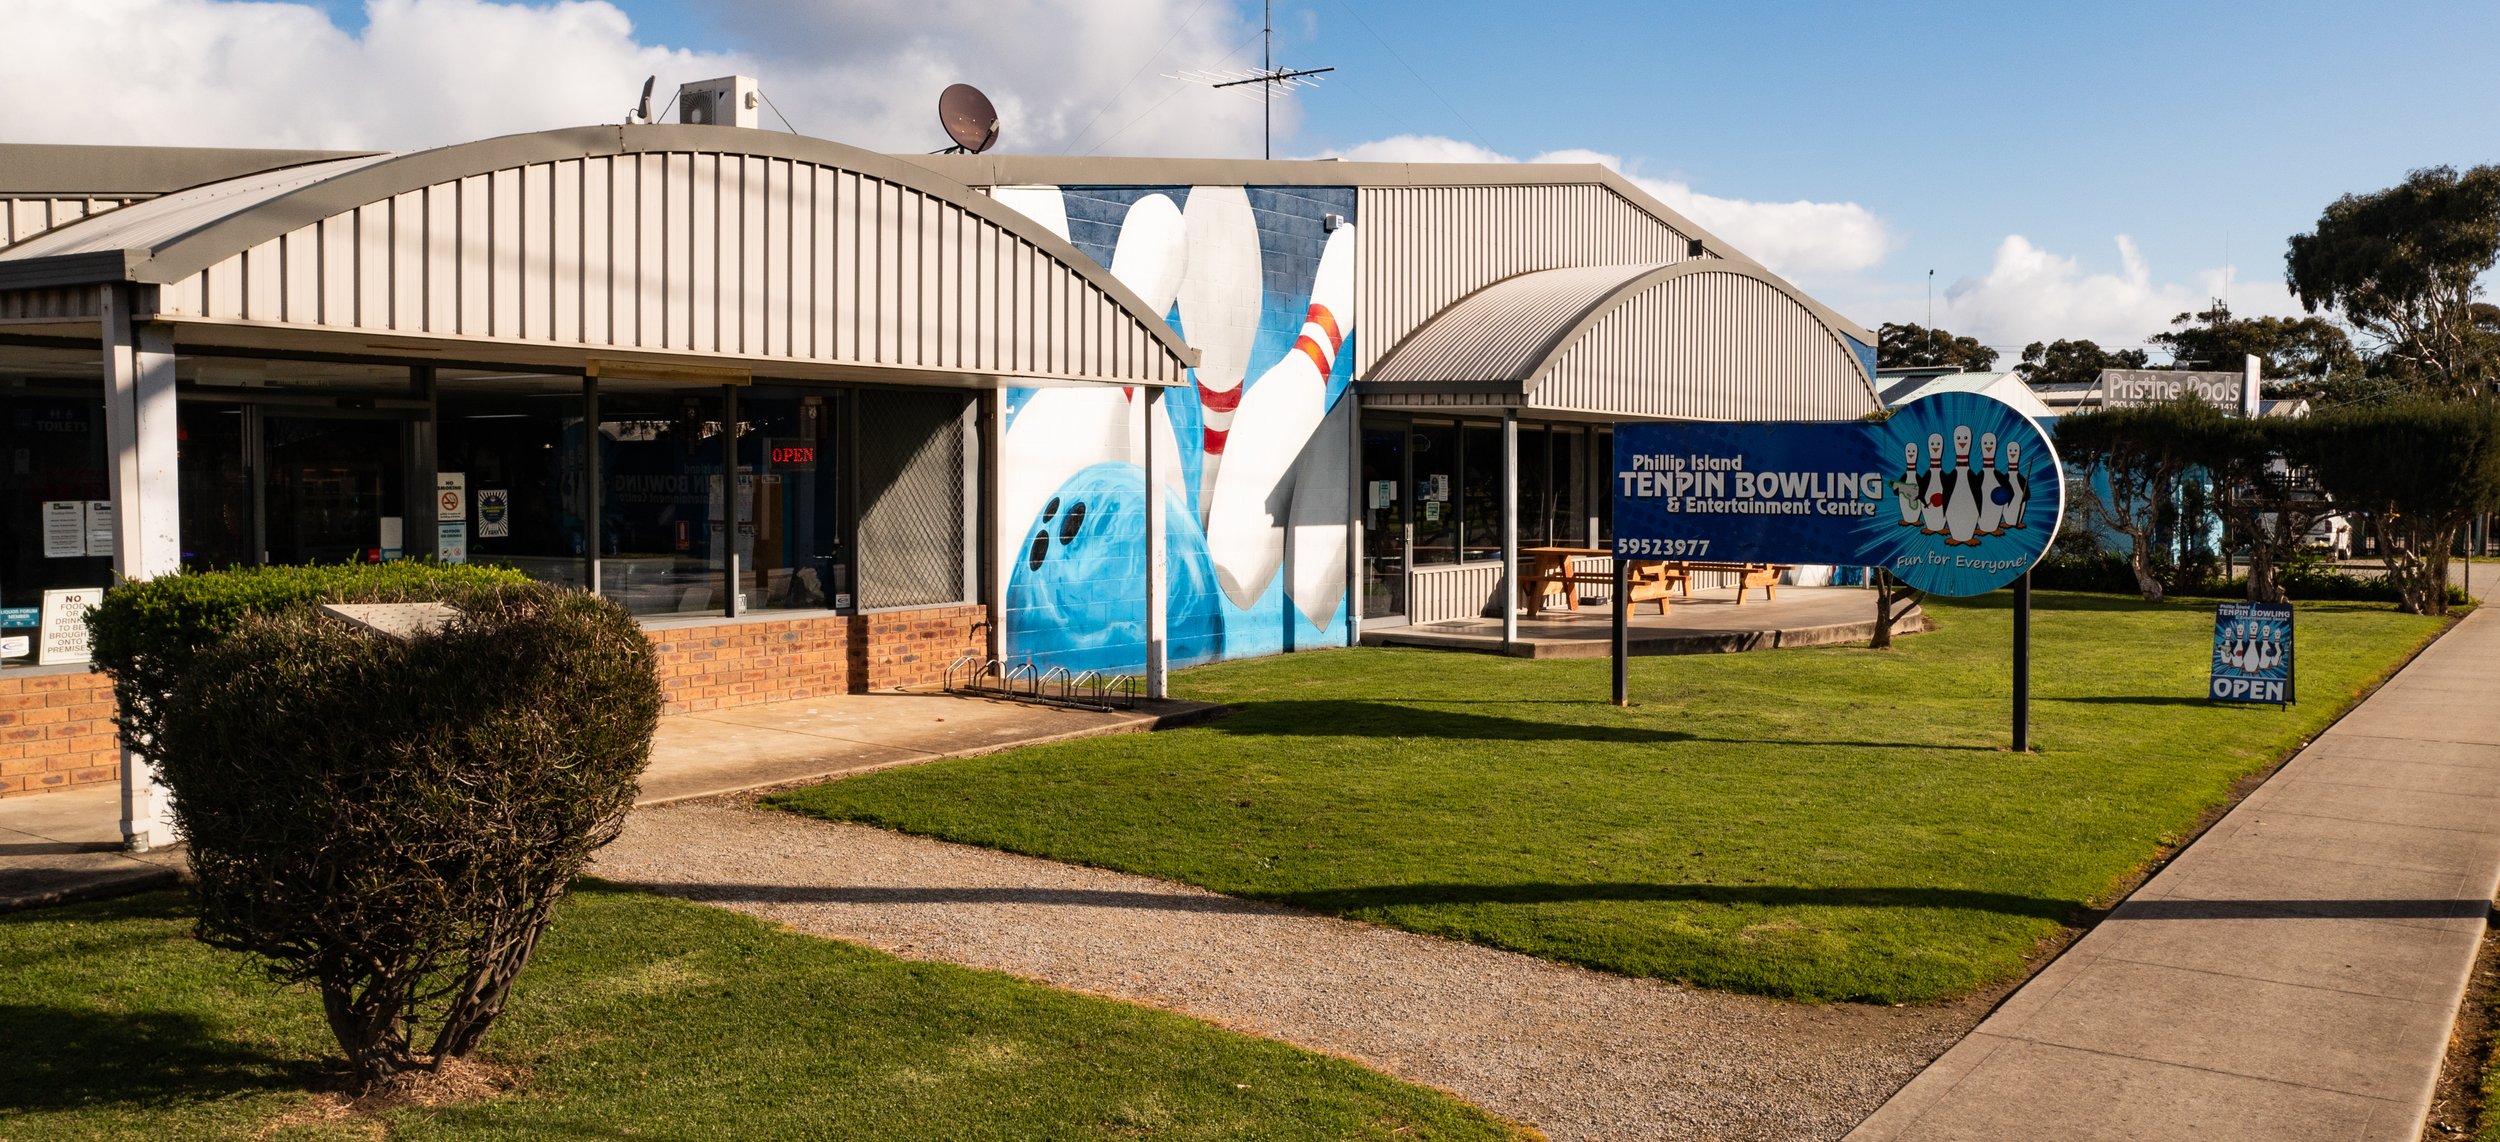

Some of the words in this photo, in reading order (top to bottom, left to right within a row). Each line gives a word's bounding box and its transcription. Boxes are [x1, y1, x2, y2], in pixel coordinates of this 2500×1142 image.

[2109, 373, 2181, 400] Pristine
[2187, 375, 2240, 402] Pools
[2109, 400, 2128, 408] POOL
[37, 420, 88, 432] TOILETS
[771, 447, 815, 463] OPEN
[1632, 454, 1686, 475] Phillip
[1691, 454, 1742, 471] Island
[1619, 471, 1725, 497] TENPIN
[1735, 471, 1882, 499] BOWLING
[1667, 497, 1680, 513] &
[1686, 496, 1811, 515] Entertainment
[1816, 498, 1876, 515] Centre
[1618, 538, 1710, 556] 59523977
[1897, 555, 1923, 569] Fun
[1928, 551, 1950, 565] for
[1956, 553, 2028, 574] Everyone!
[65, 595, 81, 603] NO
[2218, 608, 2249, 616] TENPIN
[2251, 610, 2290, 618] BOWLING
[49, 631, 87, 639] BROUGH
[57, 638, 83, 646] ONTO
[2213, 678, 2284, 701] OPEN
